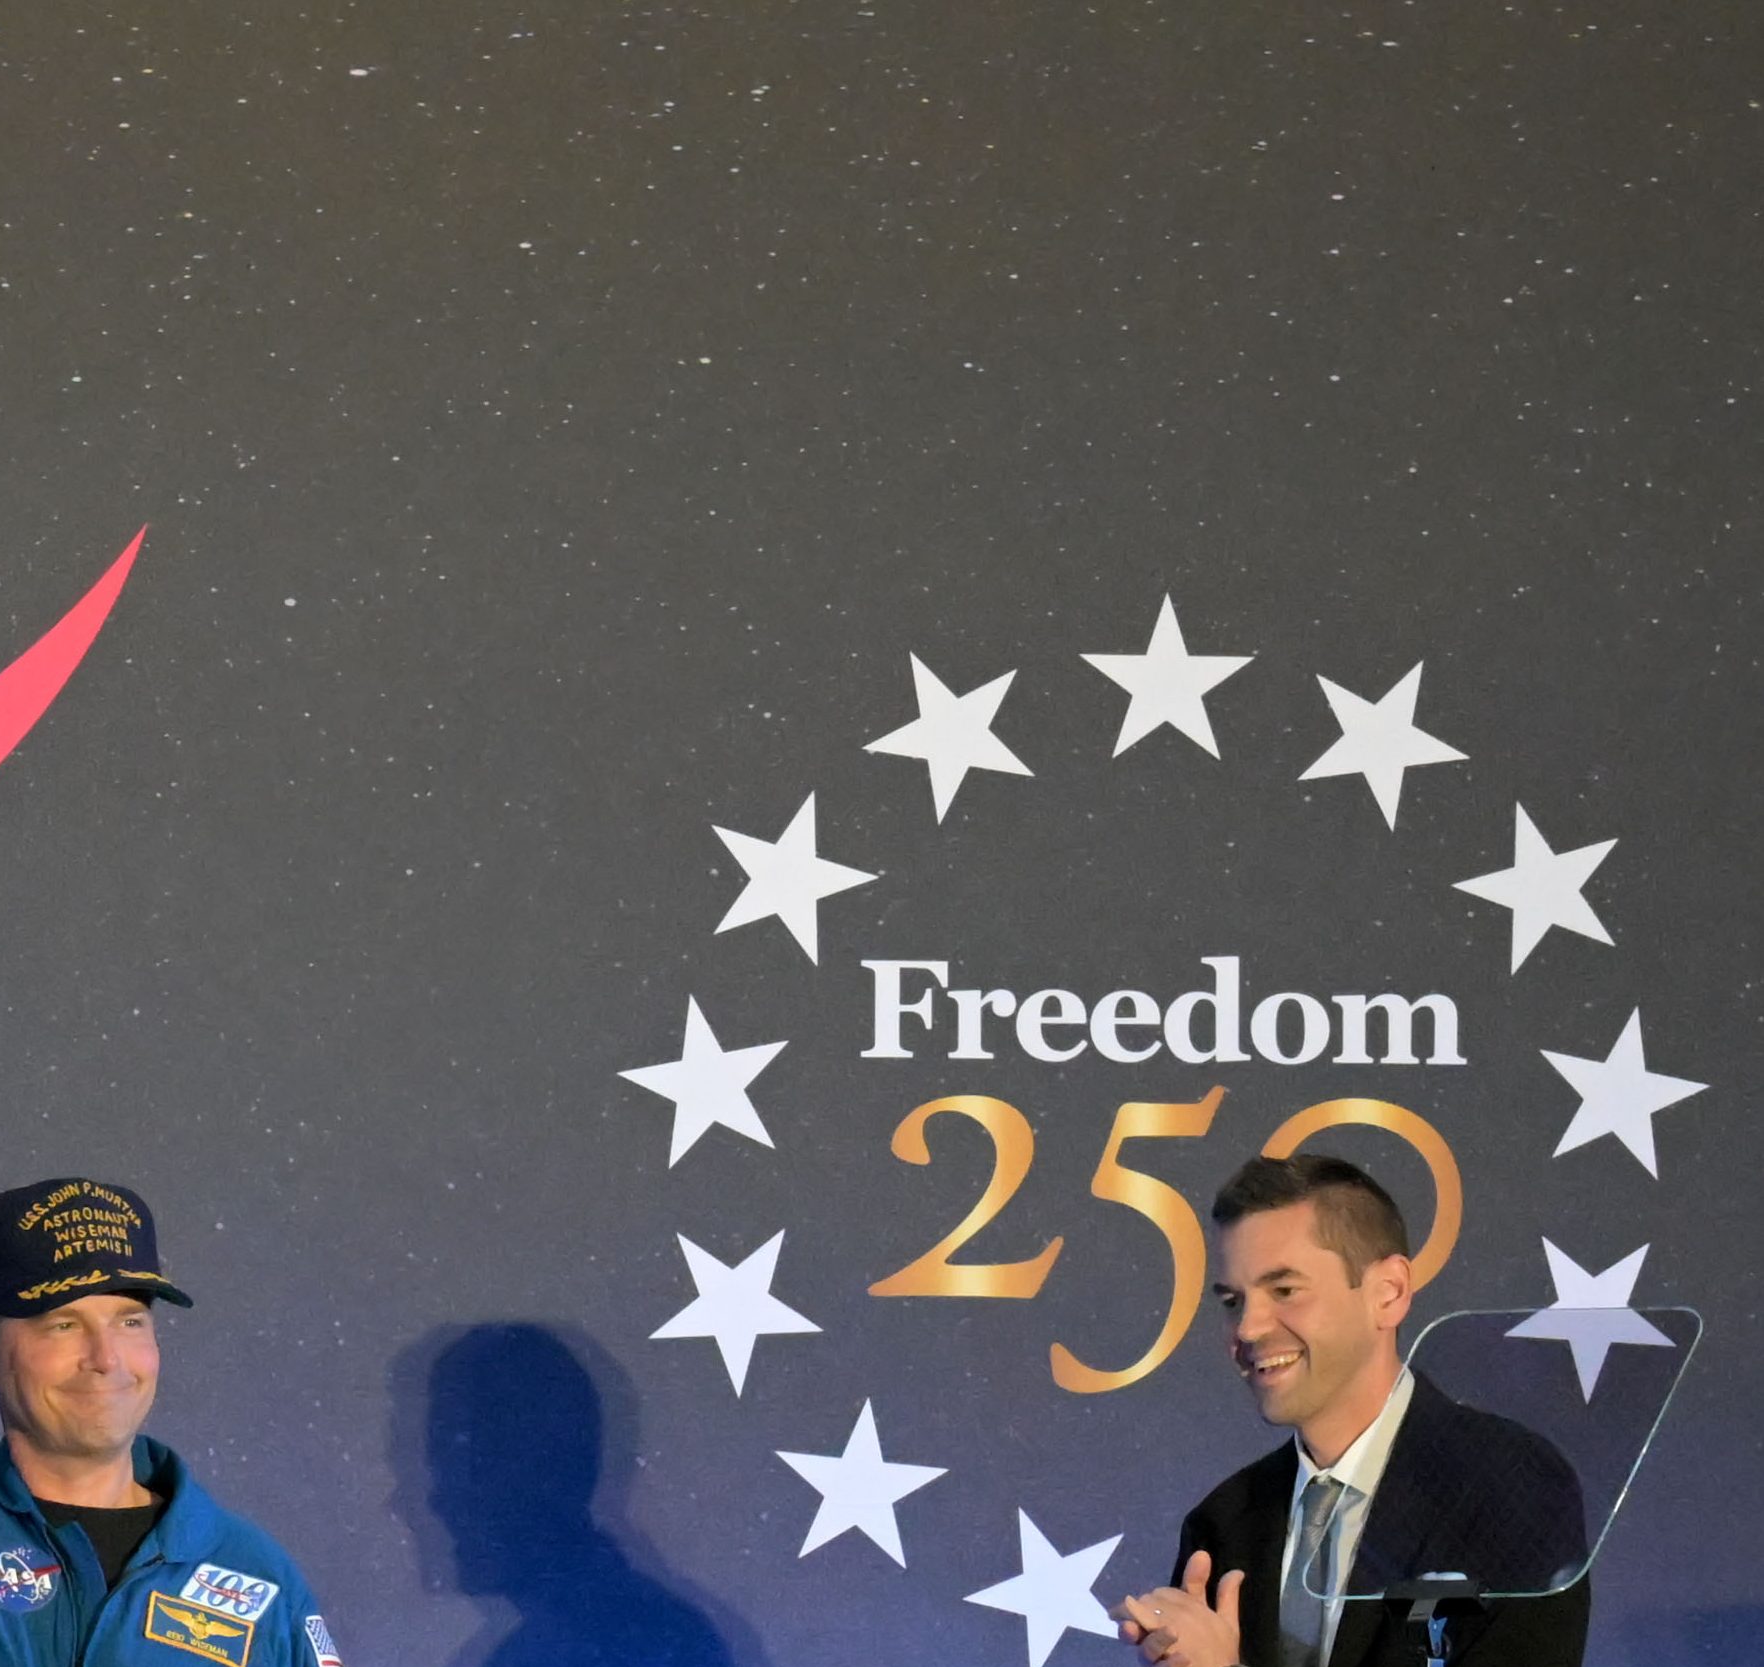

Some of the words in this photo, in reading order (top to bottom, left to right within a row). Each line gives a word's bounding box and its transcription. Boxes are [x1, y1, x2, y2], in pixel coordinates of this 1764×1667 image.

[860, 955, 1468, 1066] Freedom
[42, 1206, 129, 1232] ASTRONAUT
[47, 1182, 81, 1208] JOHN
[94, 1186, 142, 1230] MURTHA
[54, 1223, 128, 1243] WISEMAN
[53, 1239, 122, 1263] ARTEMIS
[124, 1244, 133, 1257] II
